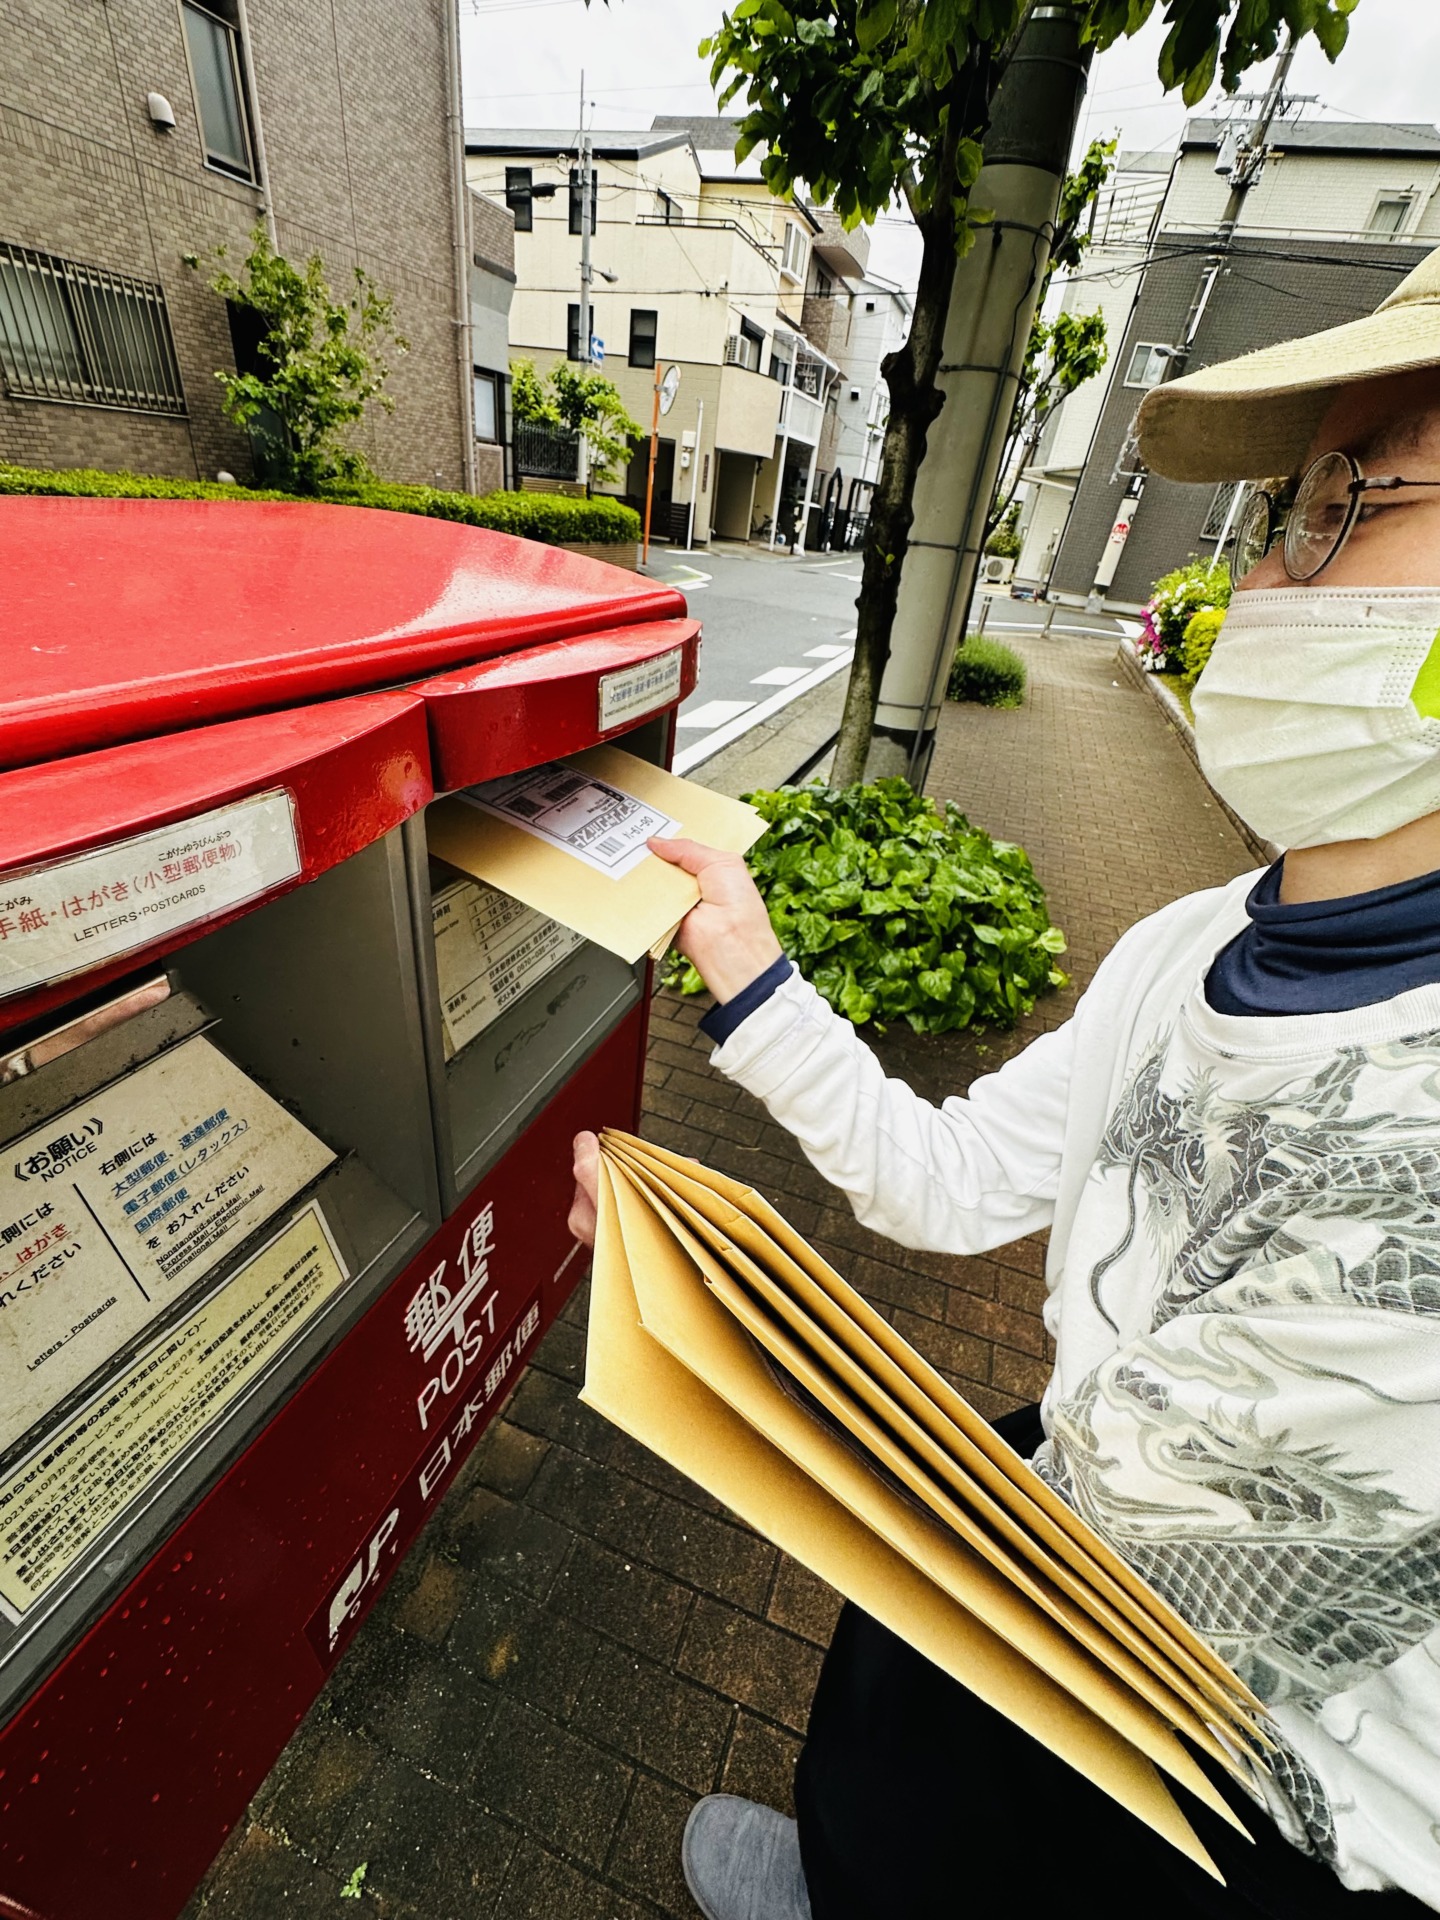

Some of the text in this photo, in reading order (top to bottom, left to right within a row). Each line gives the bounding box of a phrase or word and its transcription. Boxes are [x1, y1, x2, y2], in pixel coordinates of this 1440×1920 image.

[158, 830, 232, 862] こがたゆうびんぶつ
[40, 1142, 97, 1182] NOTICE
[98, 1132, 158, 1177] 右側には
[133, 1186, 191, 1235] 国際郵便
[145, 1165, 251, 1251] を お入れください
[155, 1193, 241, 1265] Nonstandard-sized Mail
[160, 1184, 264, 1272] Express Mail Electronic Mail
[164, 1224, 228, 1279] International Mail
[26, 1294, 117, 1372] Letters Postcards
[417, 1290, 499, 1430] POST
[419, 1300, 540, 1500] 日本郵便
